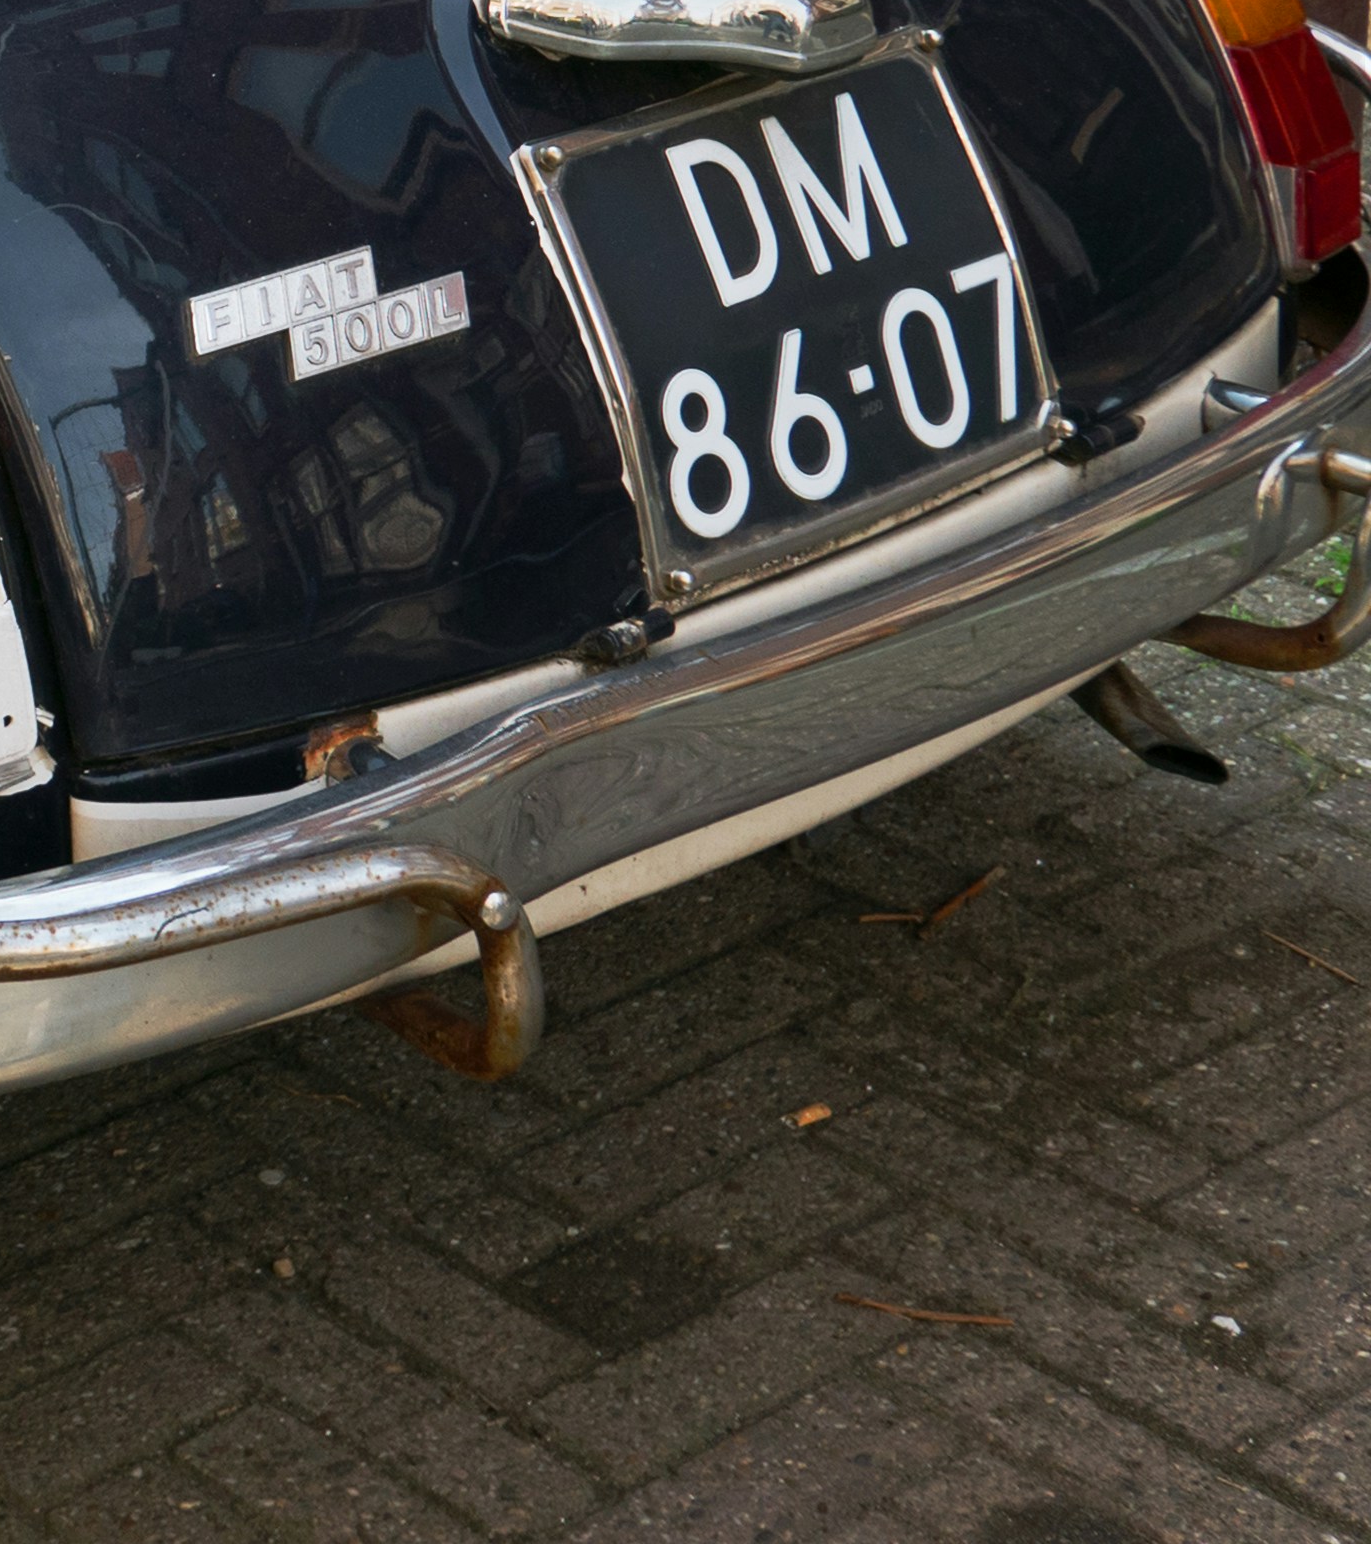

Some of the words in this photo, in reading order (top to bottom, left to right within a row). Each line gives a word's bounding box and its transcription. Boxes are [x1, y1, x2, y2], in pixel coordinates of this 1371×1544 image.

[664, 92, 909, 308] DM
[205, 258, 364, 342] FIAT
[303, 286, 465, 366] 500L
[662, 252, 1017, 539] 86-07
